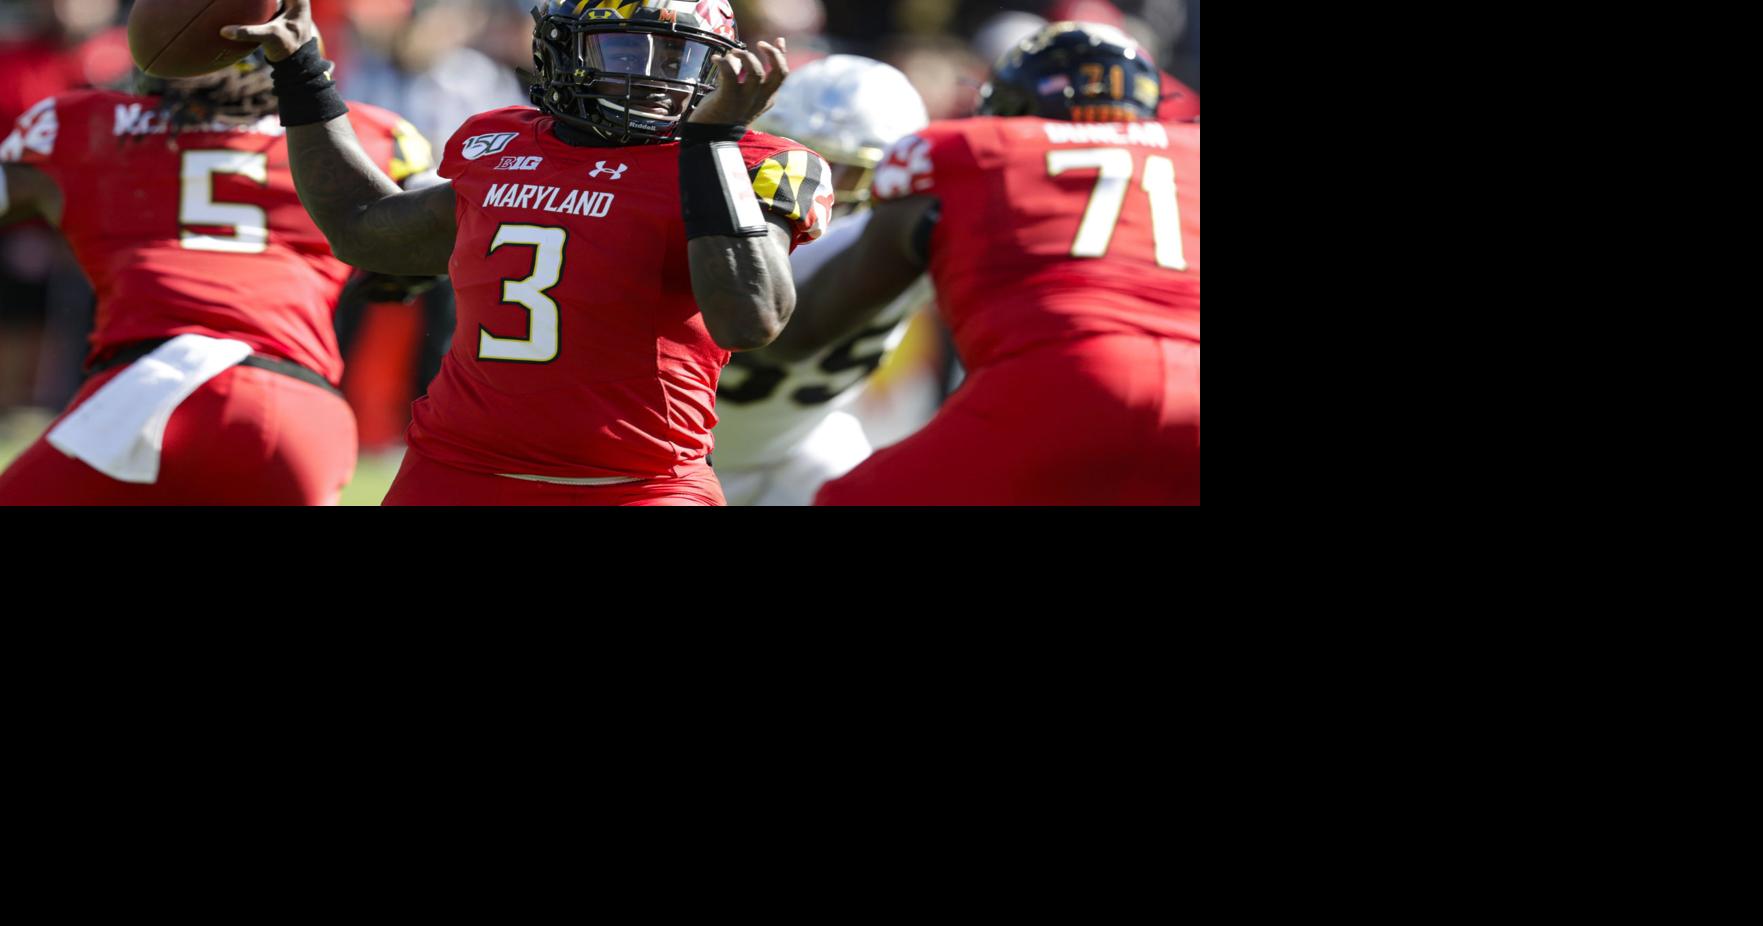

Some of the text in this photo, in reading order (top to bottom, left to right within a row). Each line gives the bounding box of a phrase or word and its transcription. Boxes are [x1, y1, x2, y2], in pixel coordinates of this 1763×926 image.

[180, 150, 268, 253] 5
[482, 183, 615, 218] MARYLAND
[1046, 147, 1188, 271] 71
[477, 221, 568, 364] 3
